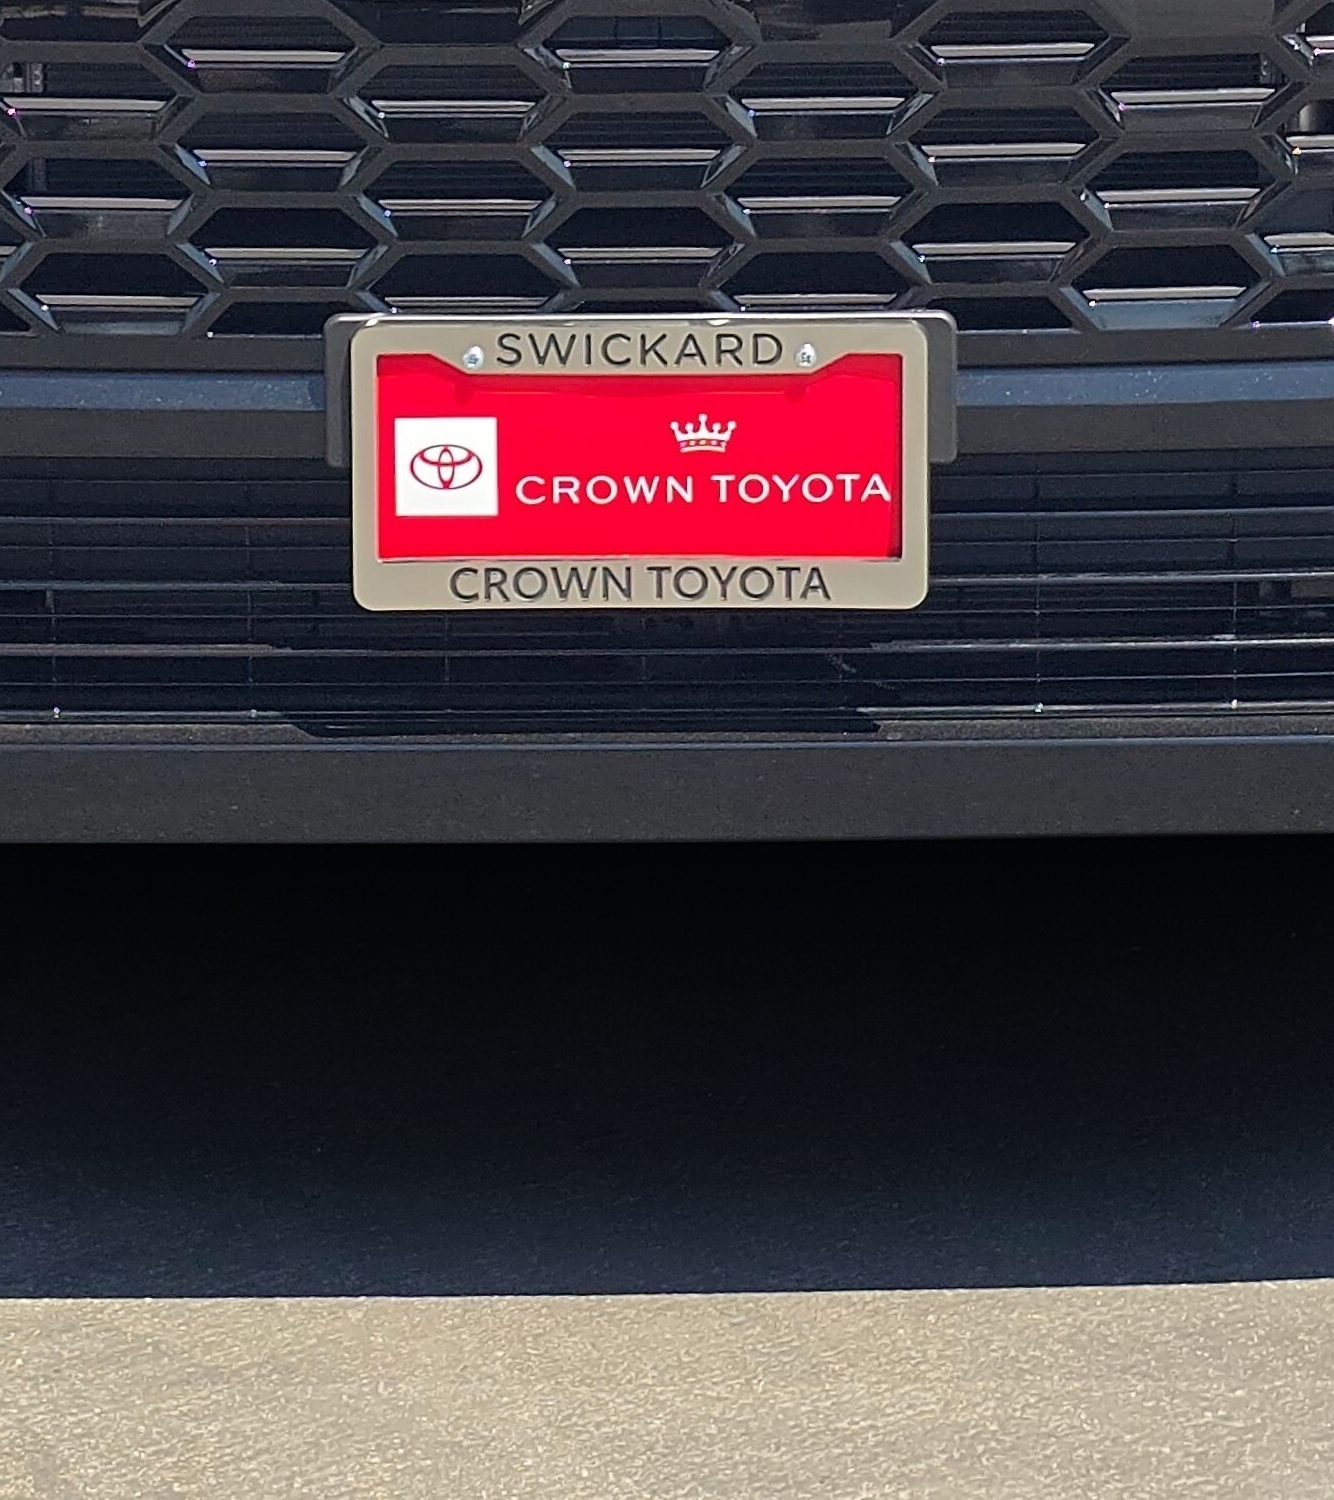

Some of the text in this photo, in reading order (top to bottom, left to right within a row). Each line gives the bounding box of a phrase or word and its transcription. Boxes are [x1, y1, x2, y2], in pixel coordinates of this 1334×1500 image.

[496, 334, 783, 366] SWICKARD
[515, 474, 891, 505] CROWN TOYOTA
[449, 566, 831, 602] CROWN TOYOTA
